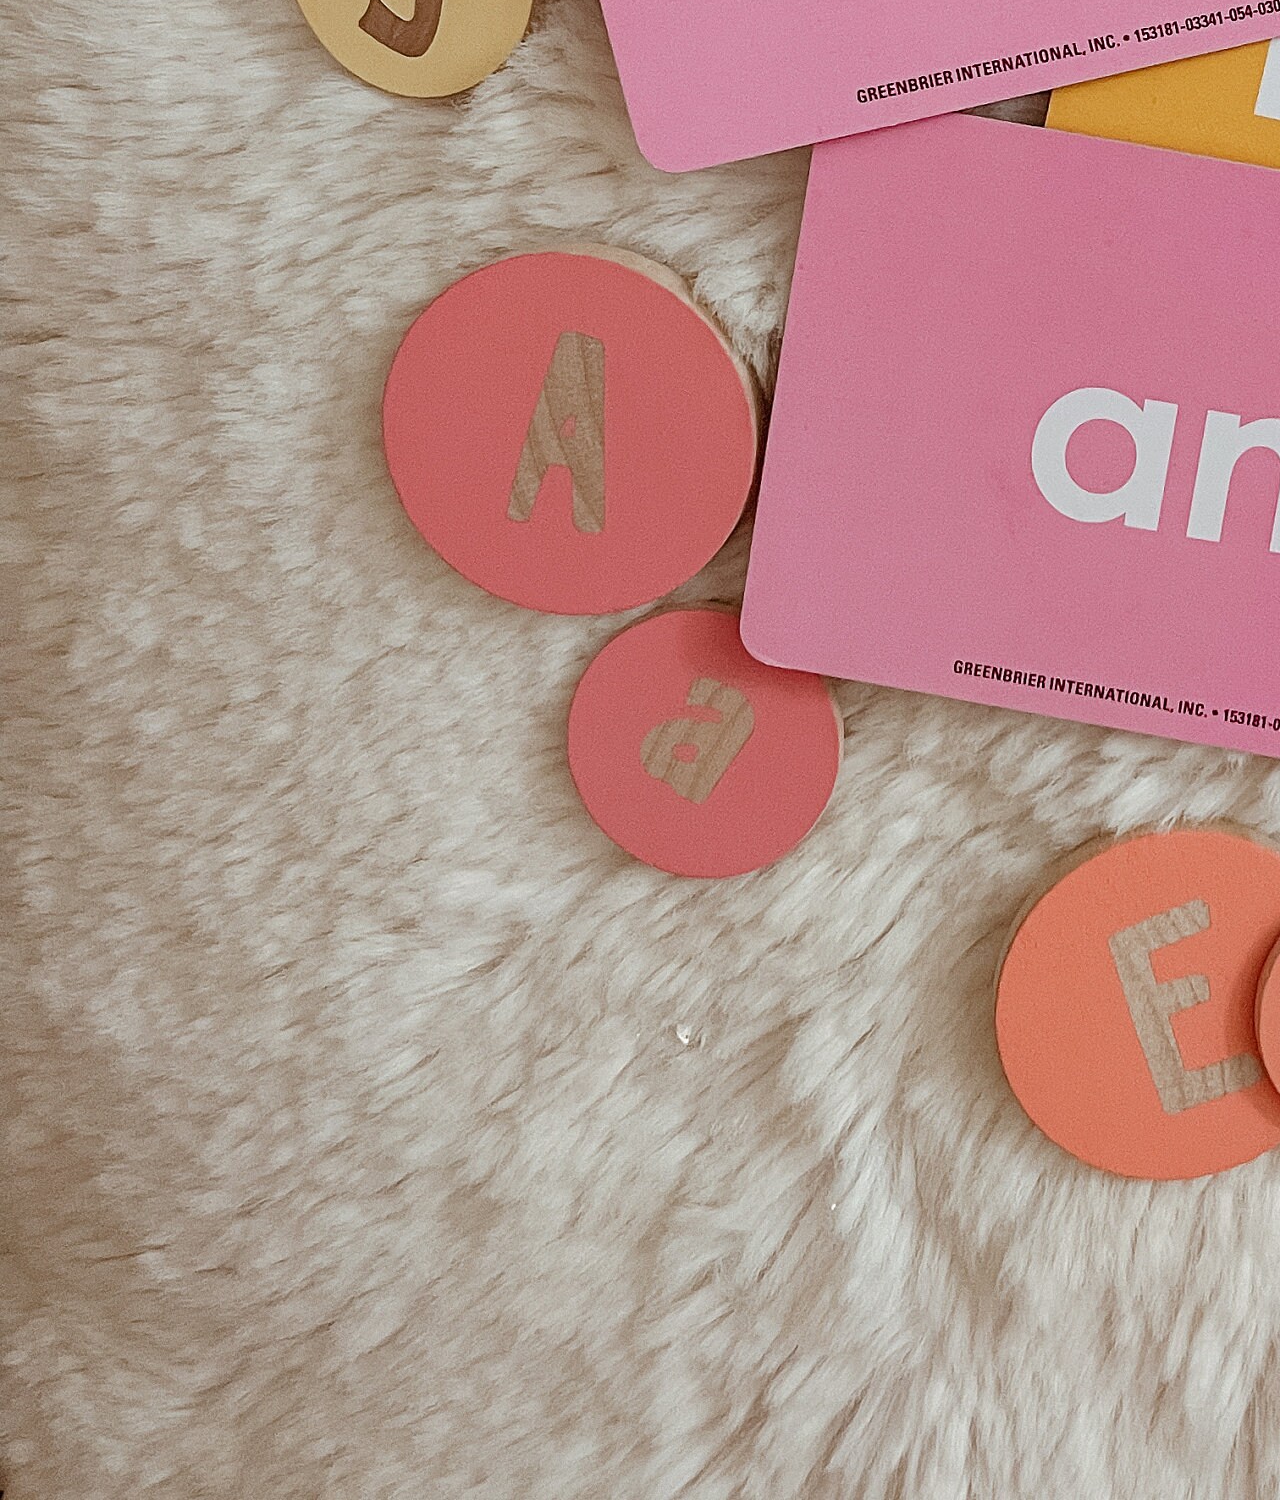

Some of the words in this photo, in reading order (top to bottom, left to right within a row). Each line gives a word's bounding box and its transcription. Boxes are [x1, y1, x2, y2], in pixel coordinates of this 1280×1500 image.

[856, 70, 954, 104] GREENBRIER
[956, 42, 1087, 83] INTERNATIONAL,
[1088, 31, 1121, 54] INC.
[507, 332, 606, 534] A
[640, 678, 755, 804] a
[952, 659, 1047, 690] GREENBRIER
[1049, 676, 1175, 714] INTERNATIONAL,
[1177, 699, 1208, 718] INC.
[1107, 899, 1263, 1115] E
